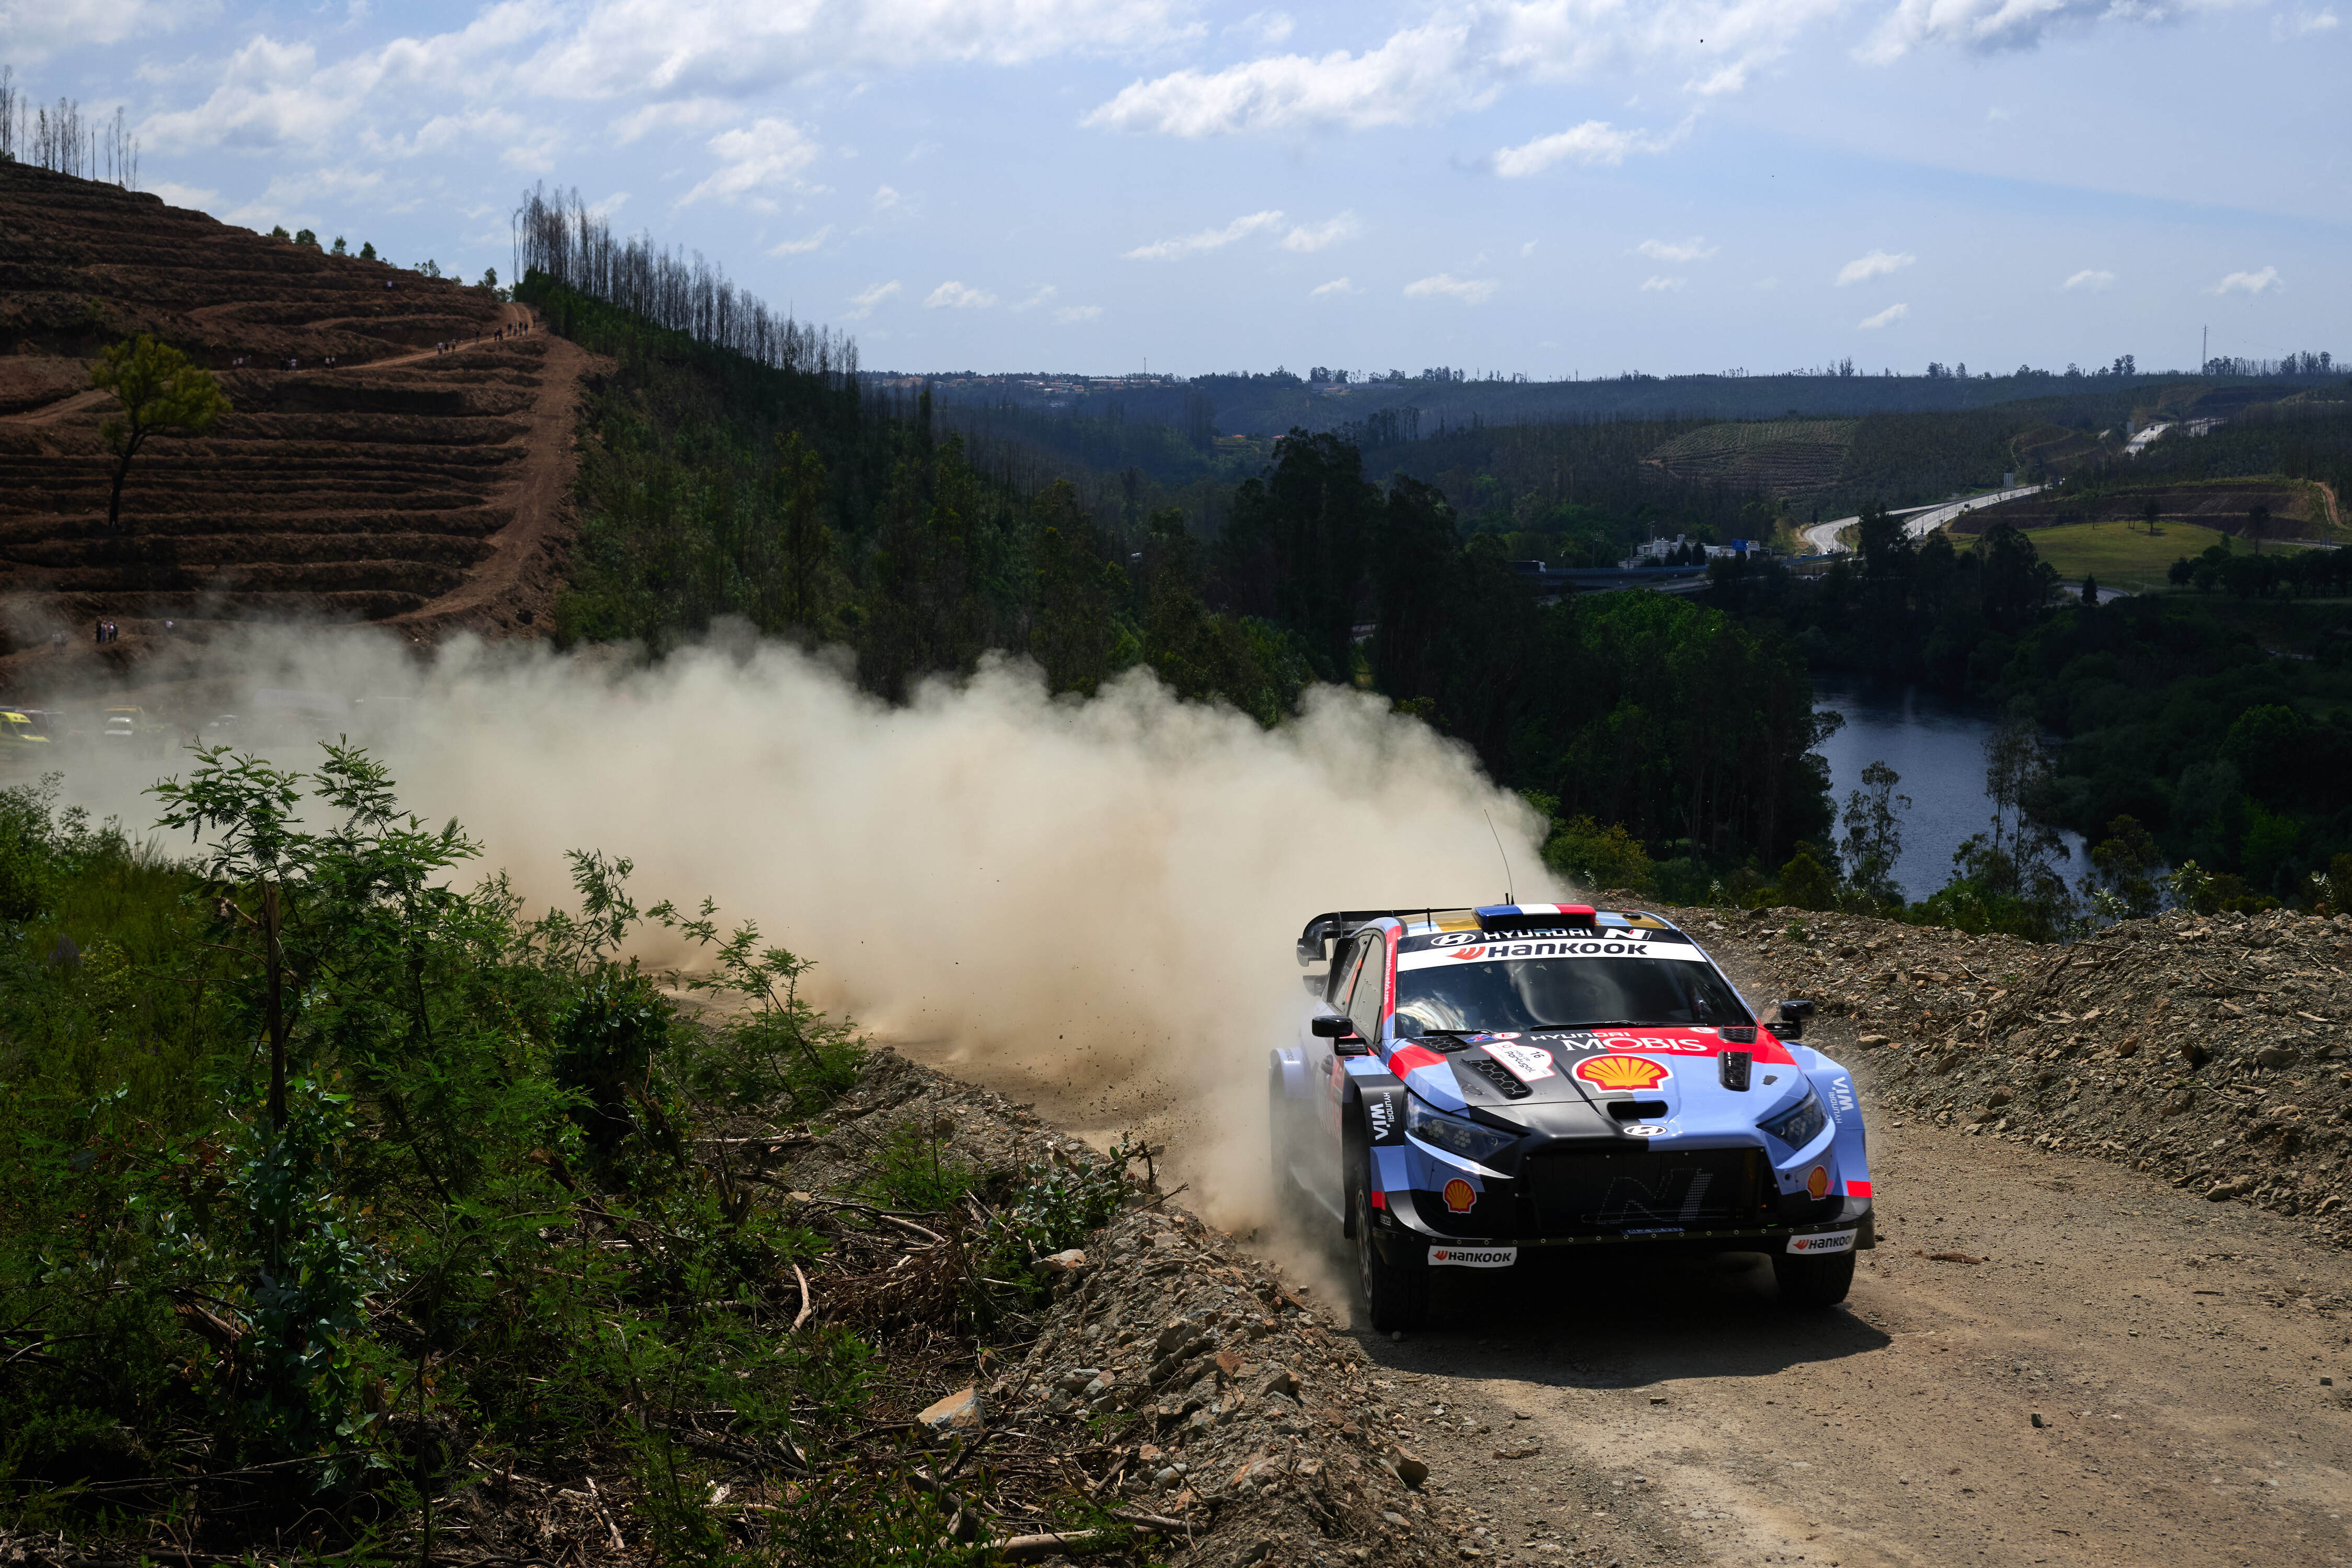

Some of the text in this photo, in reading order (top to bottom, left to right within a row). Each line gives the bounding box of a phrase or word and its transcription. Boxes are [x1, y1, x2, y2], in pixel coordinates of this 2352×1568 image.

[1483, 928, 1593, 940] HYUNDAI
[1530, 1032, 1631, 1041] HYUNDAI
[1560, 1037, 1708, 1051] MOBIS
[1383, 1092, 1394, 1122] HYUNDAI
[1828, 1092, 1842, 1124] HYUNDAI
